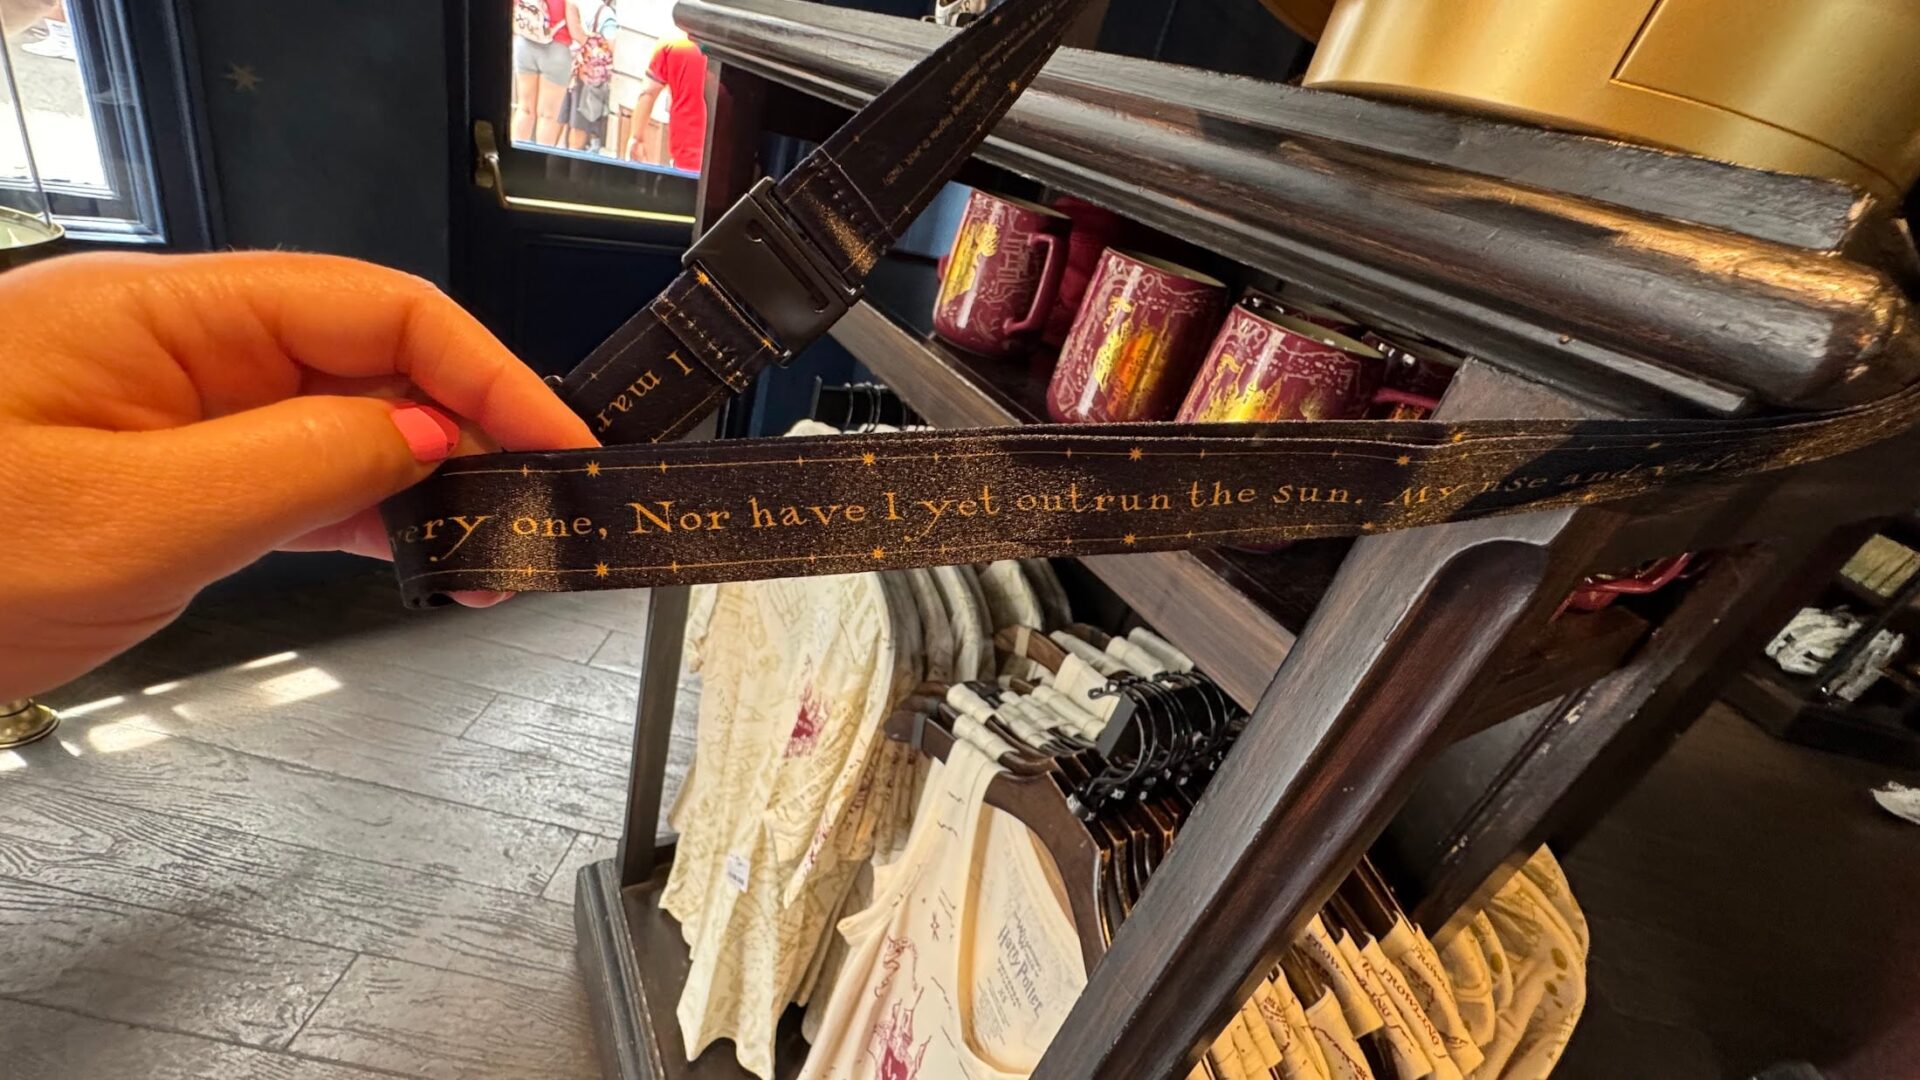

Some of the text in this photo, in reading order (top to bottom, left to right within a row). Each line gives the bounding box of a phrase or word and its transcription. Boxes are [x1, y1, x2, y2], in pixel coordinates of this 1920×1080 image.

[596, 351, 694, 433] I mar
[512, 516, 608, 540] one,
[626, 500, 730, 534] Nor
[748, 496, 867, 529] have
[883, 490, 902, 521] I
[903, 485, 1000, 543] yet
[1016, 483, 1172, 513] outrun
[1186, 480, 1259, 508] the
[1271, 484, 1363, 505] sun.
[1384, 483, 1470, 506] My
[998, 924, 1021, 967] Harry
[1015, 958, 1043, 1019] Potter
